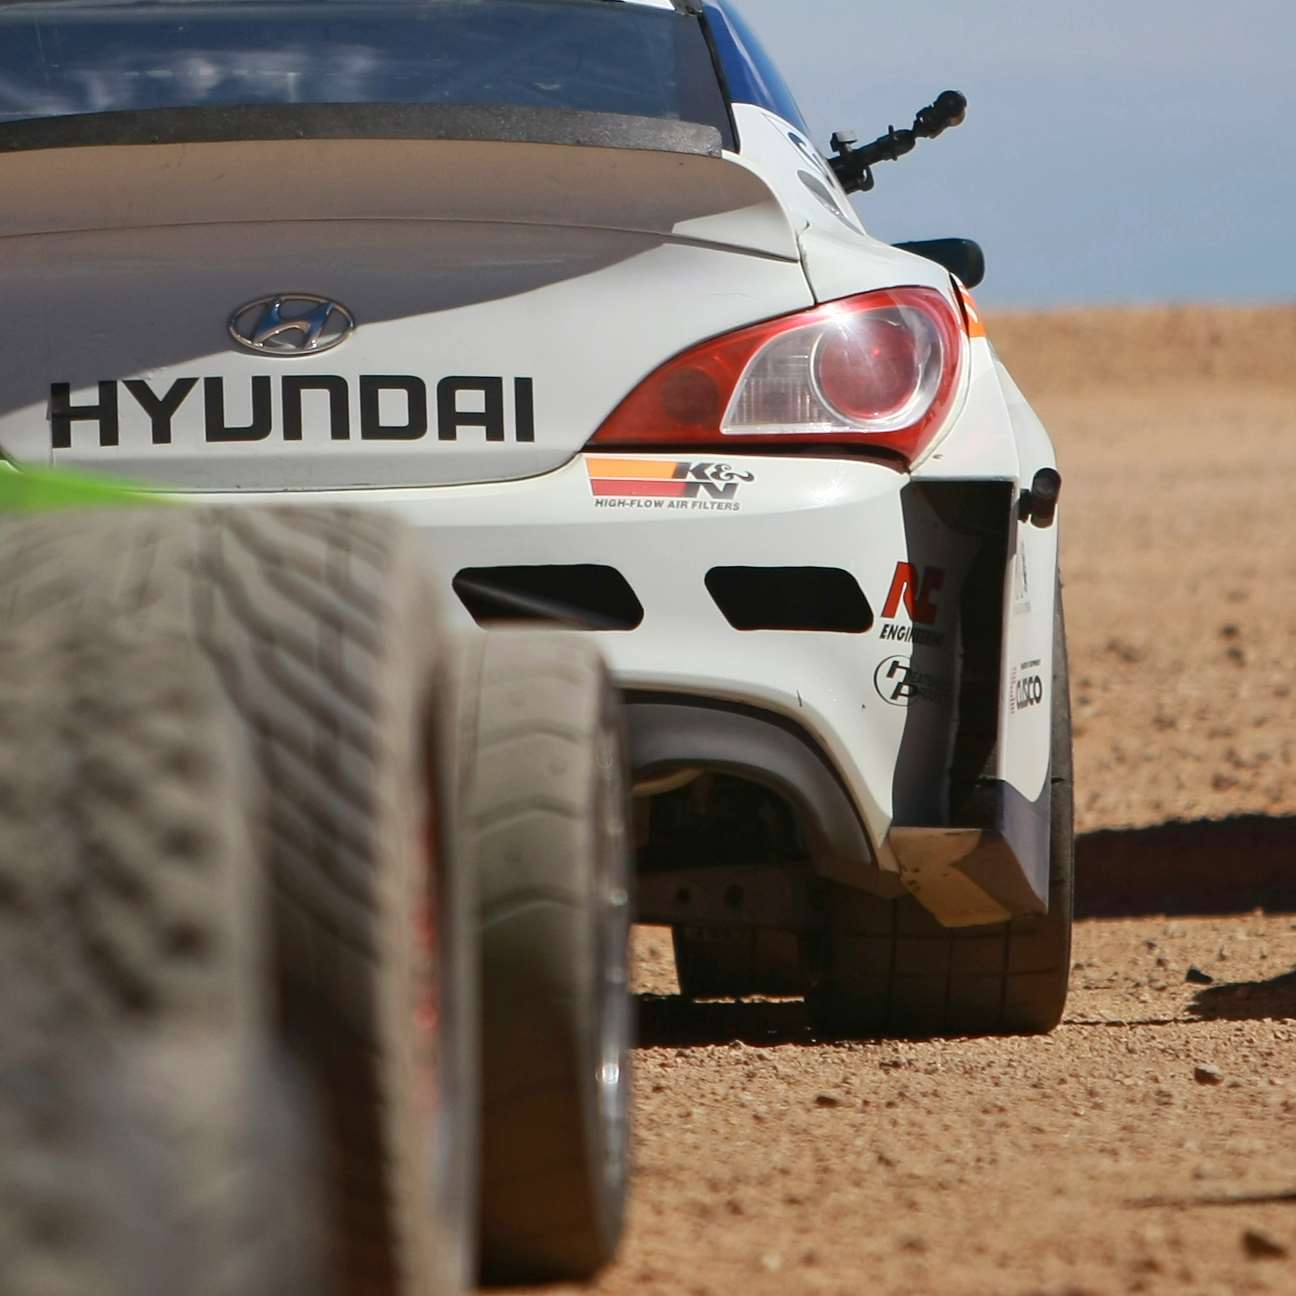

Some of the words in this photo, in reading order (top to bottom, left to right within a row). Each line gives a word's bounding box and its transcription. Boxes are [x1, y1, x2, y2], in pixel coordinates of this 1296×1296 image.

[50, 373, 536, 449] HYUNDAI
[594, 497, 665, 510] HIGH-FLOW
[667, 499, 689, 510] AIR
[690, 500, 741, 512] FILTERS
